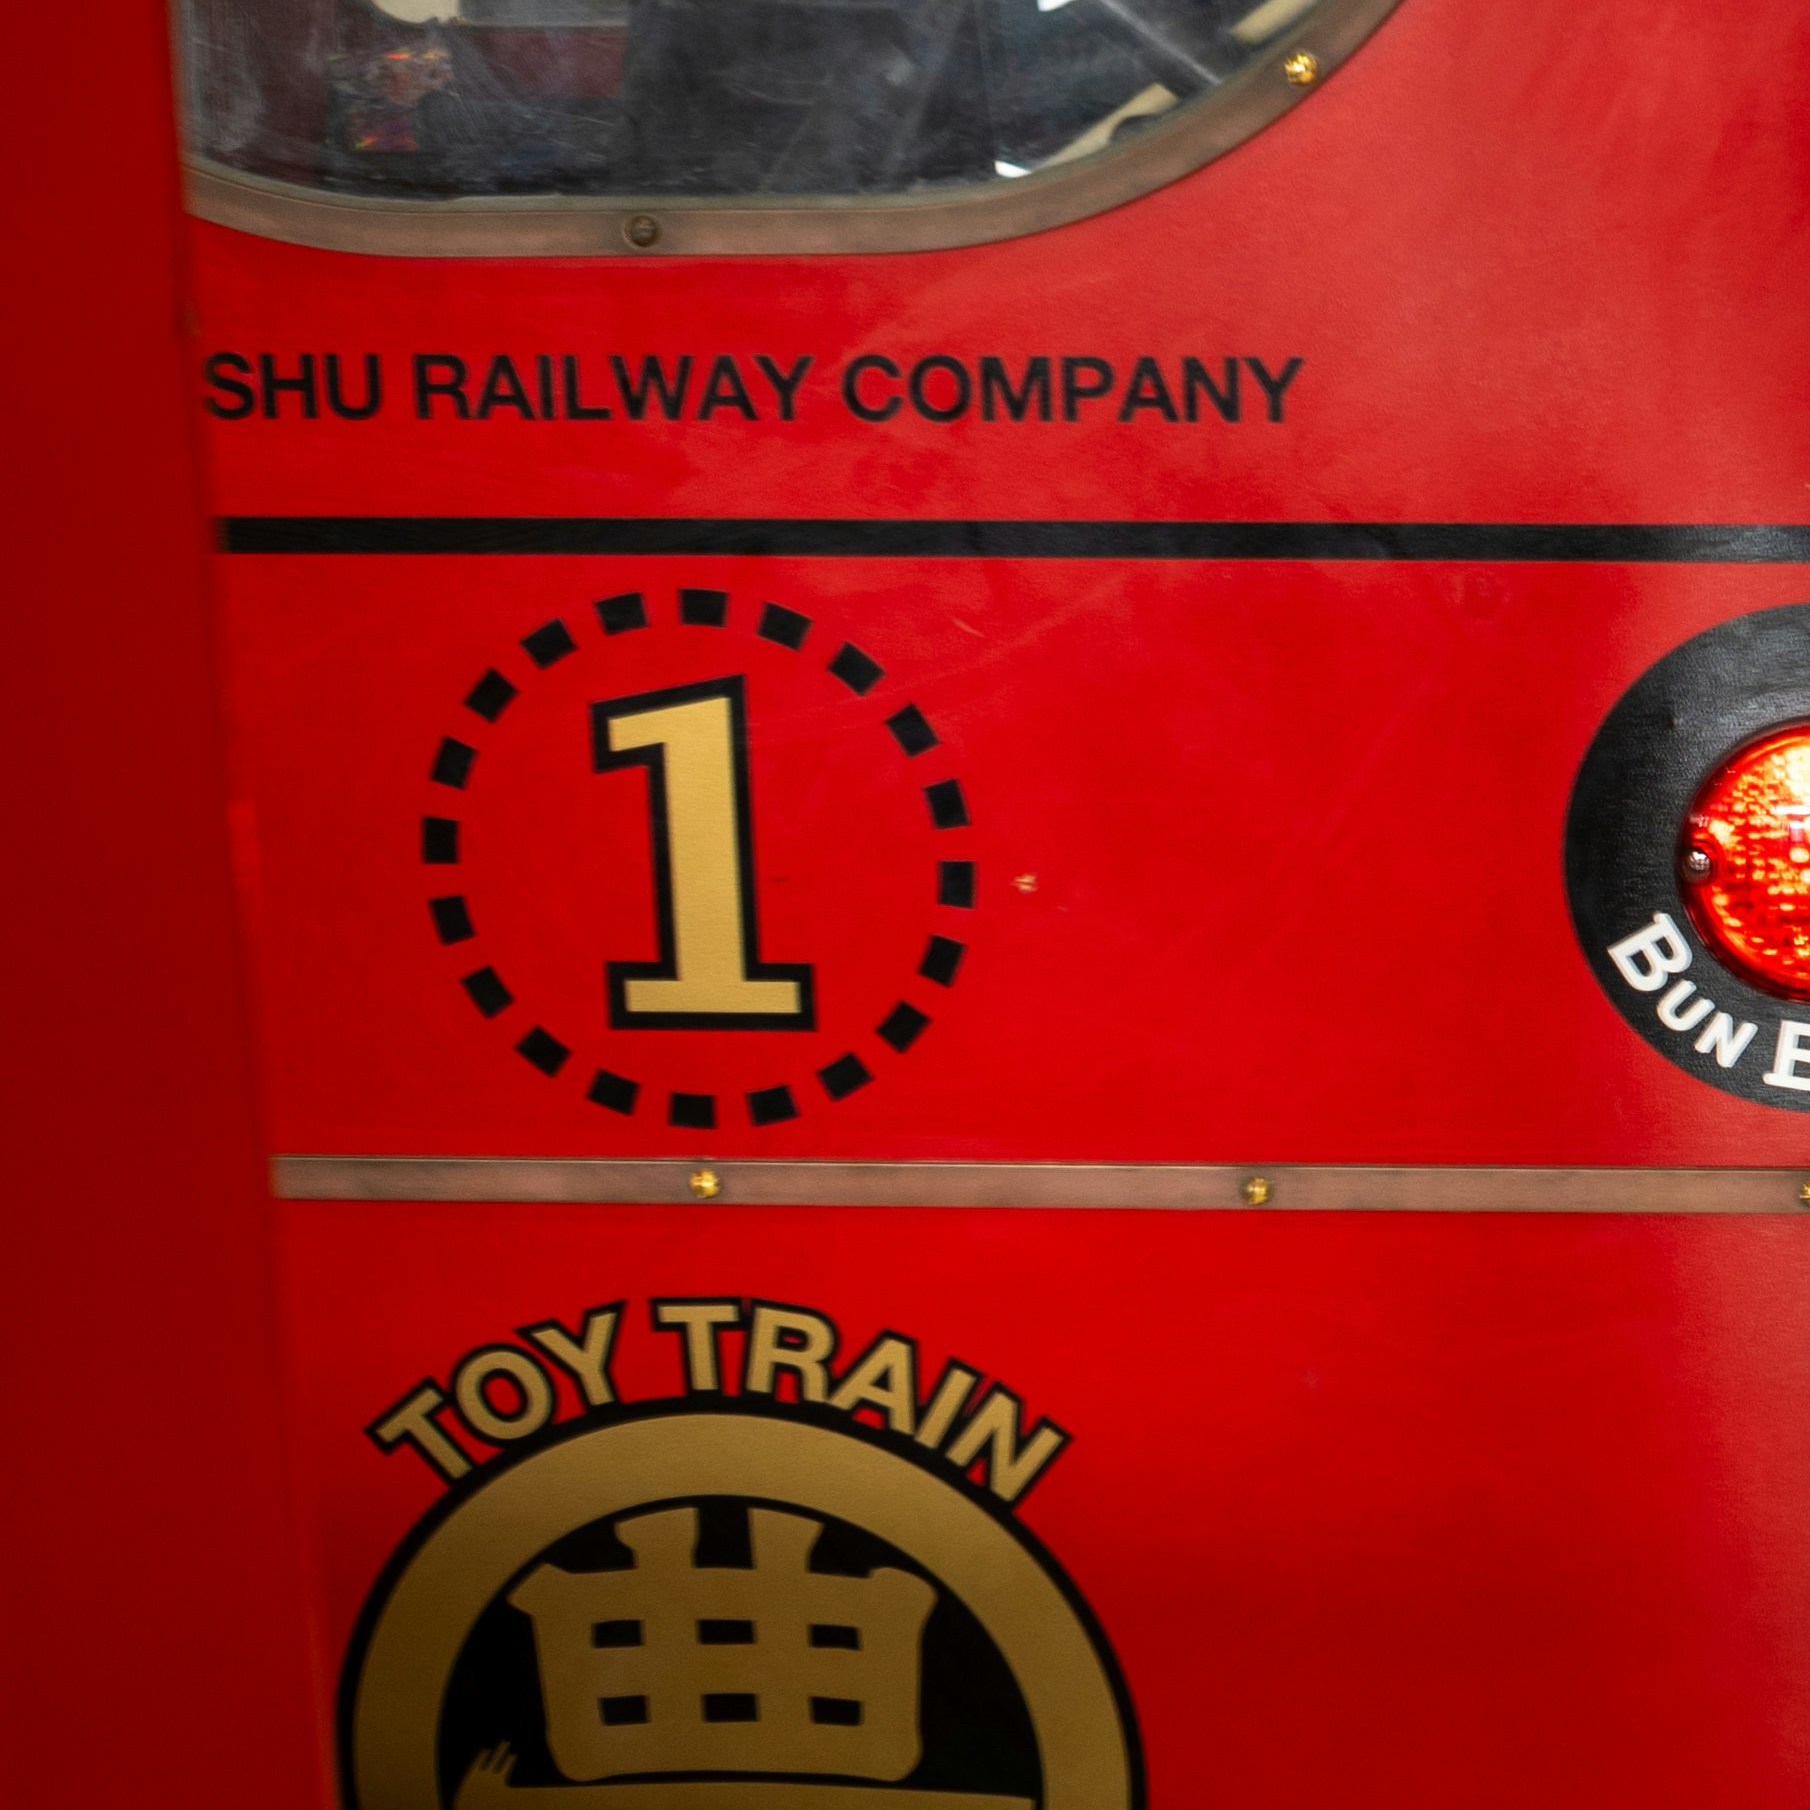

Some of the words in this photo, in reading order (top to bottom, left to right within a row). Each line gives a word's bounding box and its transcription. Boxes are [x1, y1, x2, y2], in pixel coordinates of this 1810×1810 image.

[203, 351, 383, 421] SHU
[415, 352, 817, 423] RAILWAY
[840, 354, 1303, 425] COMPANY
[590, 674, 817, 1032] 1
[364, 1299, 626, 1488] TOY
[650, 1296, 1074, 1511] TRAIN
